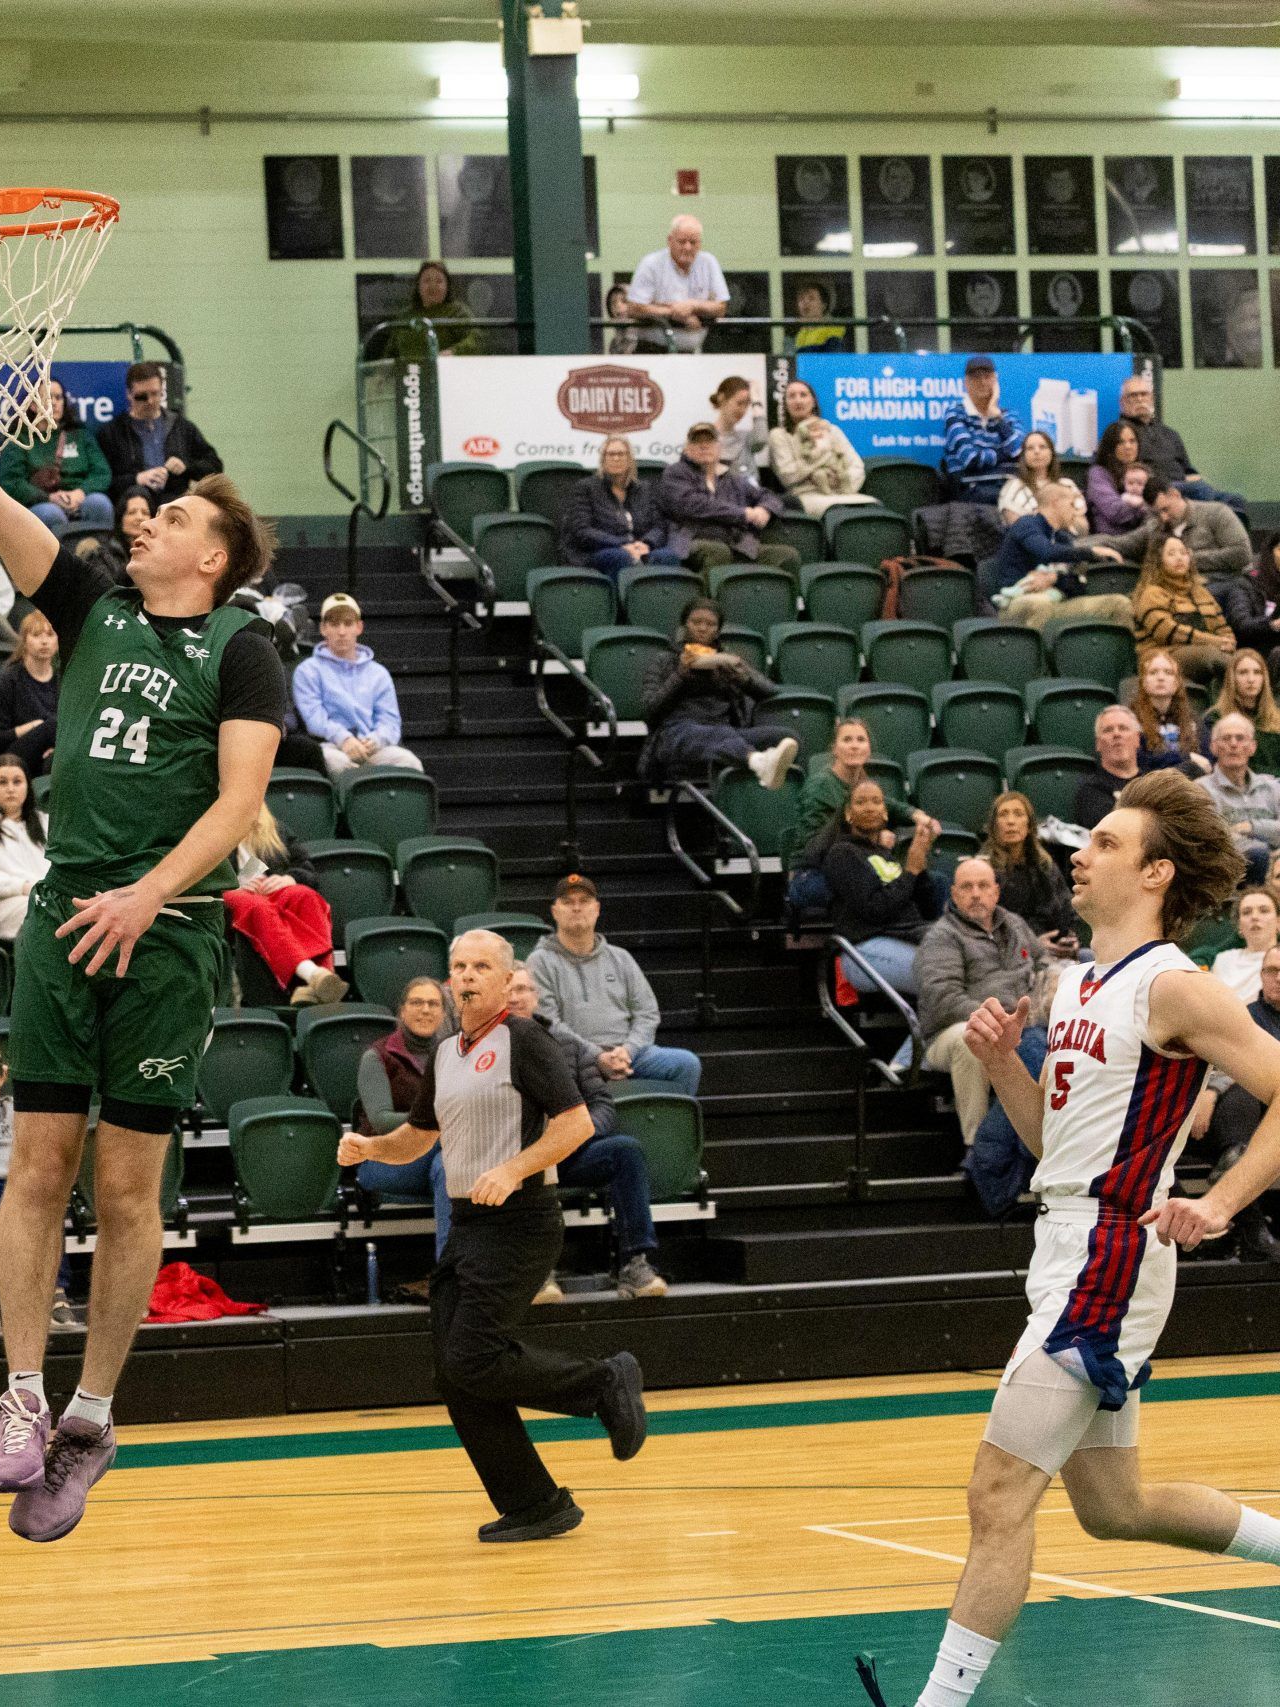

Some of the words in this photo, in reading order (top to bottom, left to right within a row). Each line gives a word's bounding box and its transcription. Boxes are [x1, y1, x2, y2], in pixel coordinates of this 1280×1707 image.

[835, 377, 870, 398] FOR
[568, 387, 615, 414] DAIRY
[616, 387, 652, 414] ISLE
[836, 400, 926, 421] CANADIAN
[464, 440, 498, 457] ADL
[514, 441, 576, 457] Comes
[99, 662, 179, 712] UPEI
[88, 706, 152, 765] 24
[1050, 1061, 1075, 1111] 5
